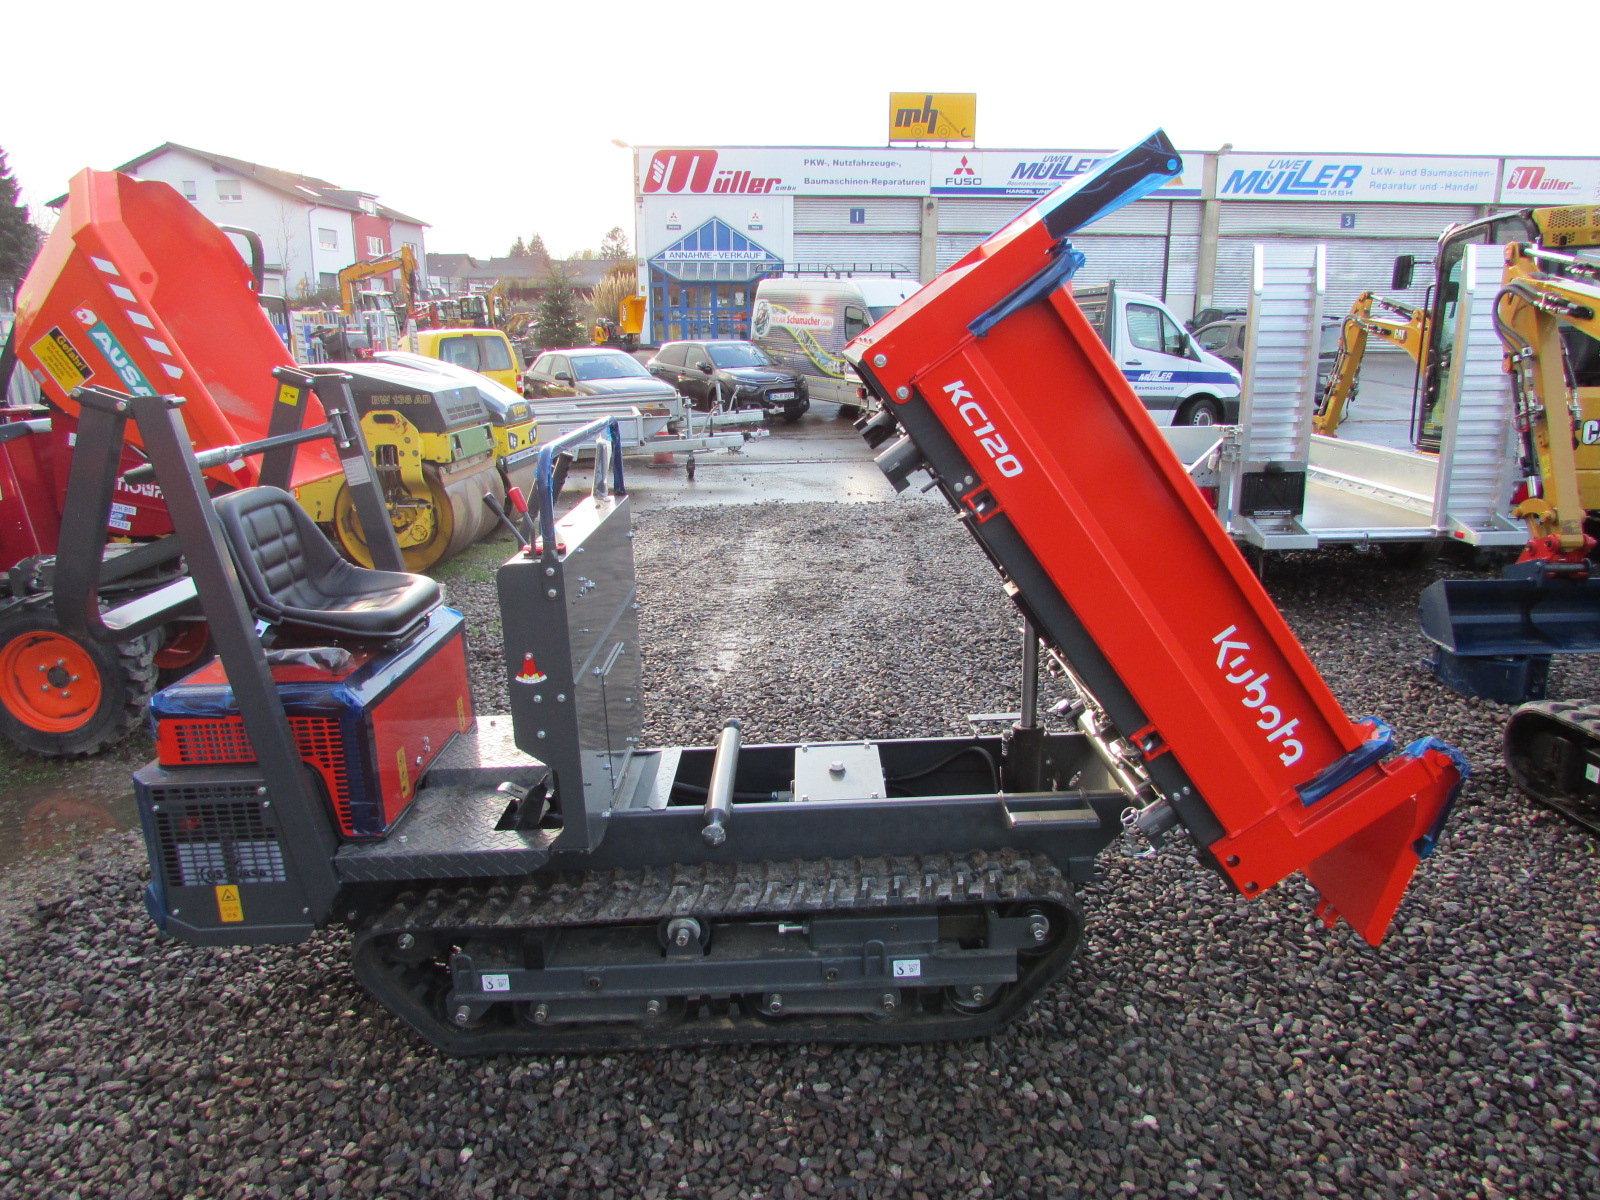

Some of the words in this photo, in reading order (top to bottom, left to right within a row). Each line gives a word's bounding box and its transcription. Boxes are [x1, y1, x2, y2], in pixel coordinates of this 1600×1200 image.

[804, 159, 830, 167] PKW-,
[832, 159, 902, 168] Nutzfahrzeuge-,
[1268, 160, 1304, 169] UWE
[1220, 160, 1362, 195] MÜLLER
[1370, 167, 1396, 176] LKW-
[1399, 168, 1417, 176] und
[1420, 168, 1494, 178] Baumaschinen-
[804, 178, 926, 186] Baumaschinen-Reparaturen
[945, 178, 982, 186] FUSO
[1369, 181, 1417, 191] Reparatur
[1419, 182, 1437, 190] und
[1440, 183, 1478, 192] -Handel
[786, 315, 820, 326] Schumacher
[56, 336, 88, 372] Gefahr!
[942, 380, 1024, 478] KC120
[1212, 624, 1304, 768] Kubota
